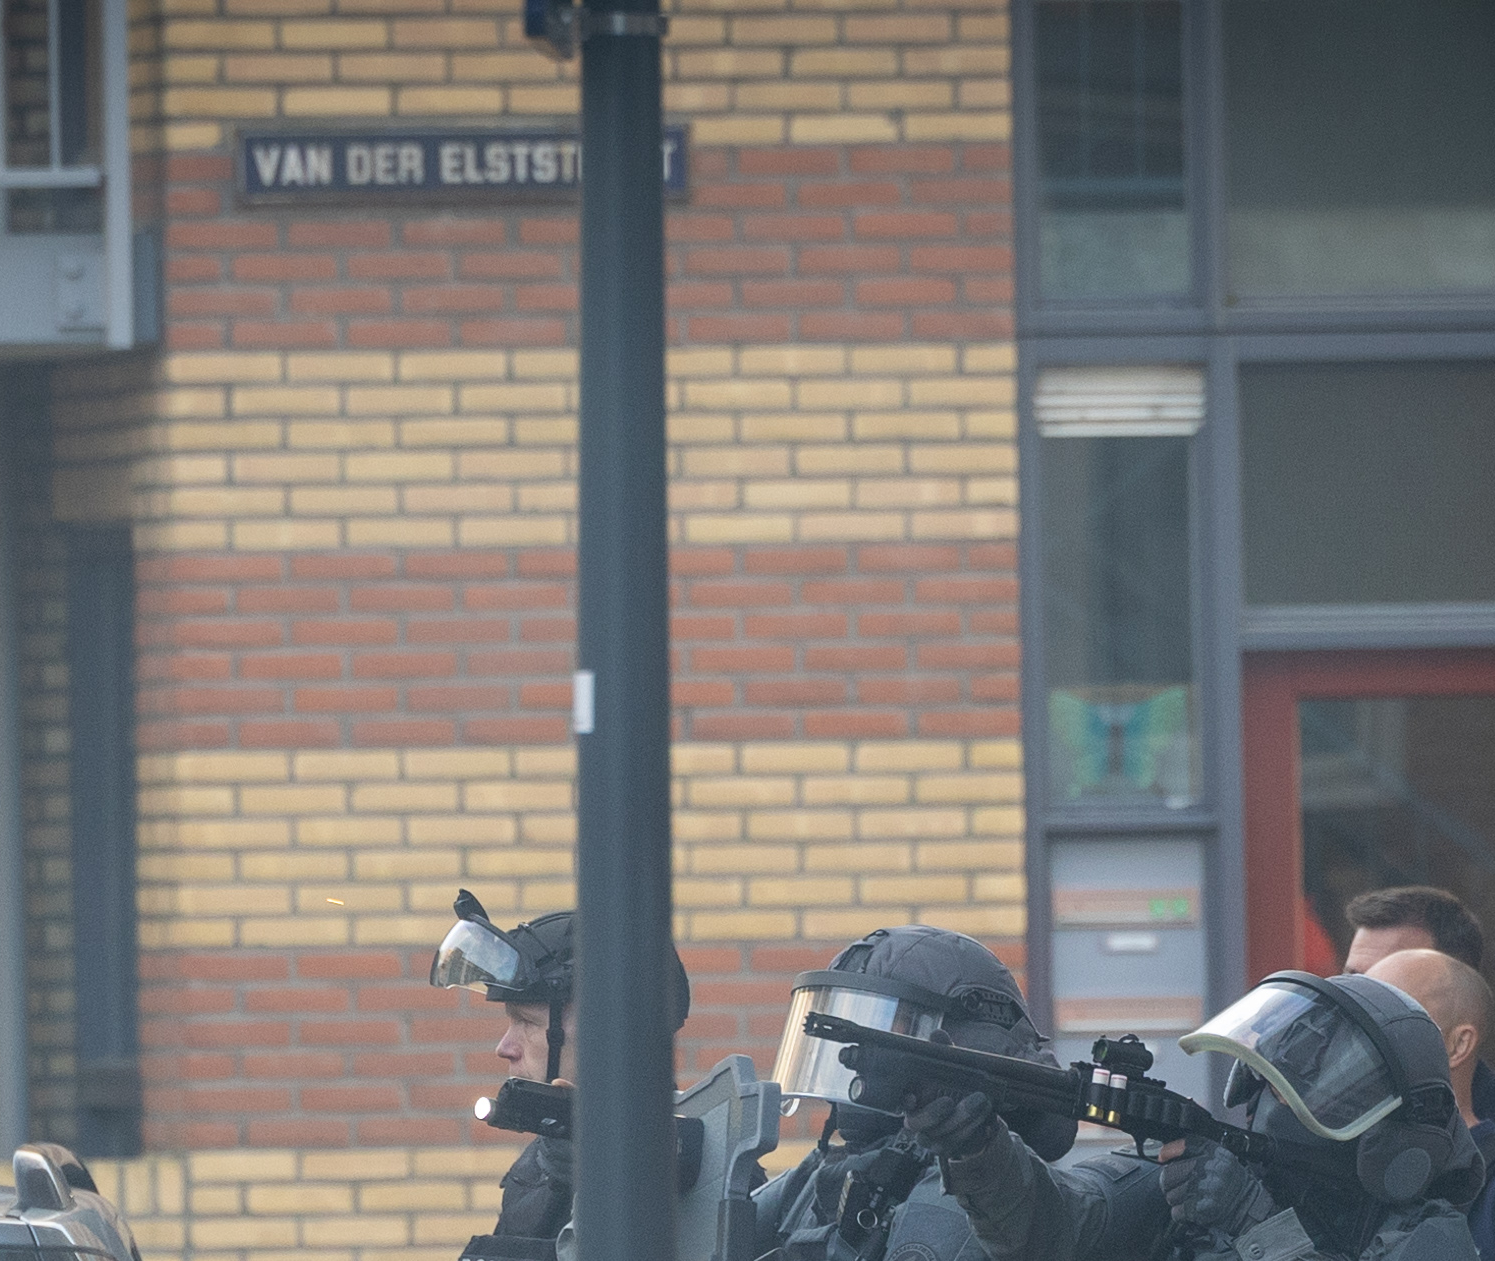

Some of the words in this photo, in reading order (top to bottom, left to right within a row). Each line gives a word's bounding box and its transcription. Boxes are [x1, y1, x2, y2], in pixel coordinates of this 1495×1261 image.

[253, 142, 333, 187] VAN
[346, 142, 425, 186] DER
[438, 140, 677, 184] ELSTSTT
